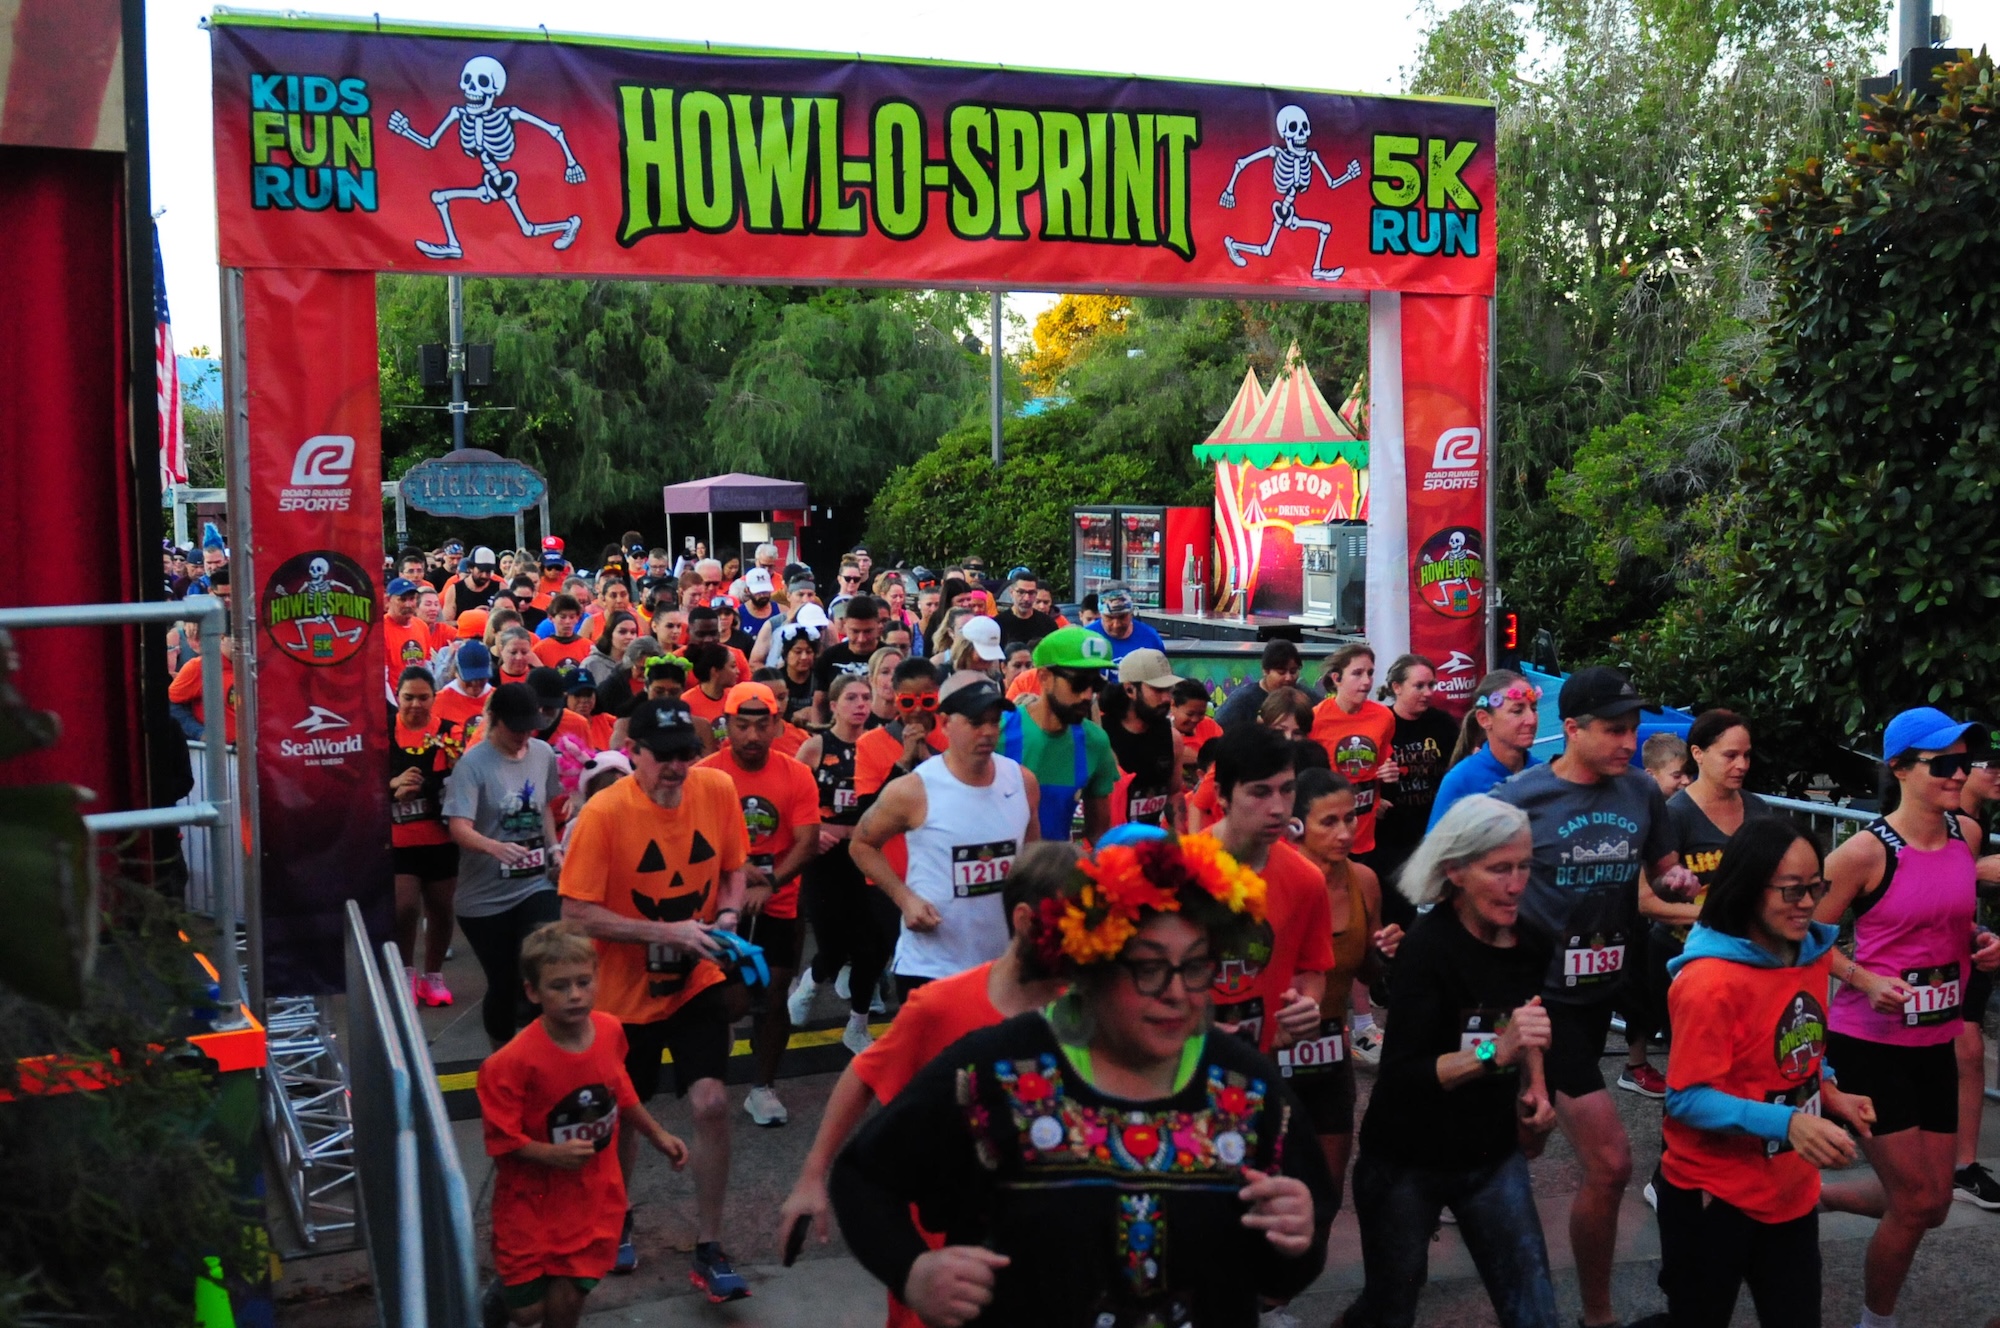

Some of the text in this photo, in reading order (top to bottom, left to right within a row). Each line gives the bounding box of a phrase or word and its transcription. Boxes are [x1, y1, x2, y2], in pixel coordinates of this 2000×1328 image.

[251, 75, 367, 113] KIDS
[253, 114, 374, 167] FUN
[618, 84, 1197, 258] HOWL-O-SPRINT
[1372, 135, 1480, 210] 5K
[253, 167, 378, 211] RUN
[1373, 211, 1477, 256] RUN
[420, 473, 527, 497] TICKETS
[1259, 471, 1332, 501] BIG TOP
[1423, 478, 1478, 491] SPORTS
[1448, 470, 1479, 478] RUNNER
[278, 498, 350, 511] SPORTS
[281, 488, 352, 497] ROAD RUNNER
[1278, 505, 1310, 516] DRINKS
[1090, 640, 1101, 656] L
[280, 734, 363, 756] SeaWorld
[321, 758, 344, 766] DIEGO
[1558, 812, 1638, 838] SAN DIEGO
[1572, 950, 1619, 973] 1133
[1913, 985, 1955, 1011] 1175
[1290, 1040, 1335, 1064] 1011
